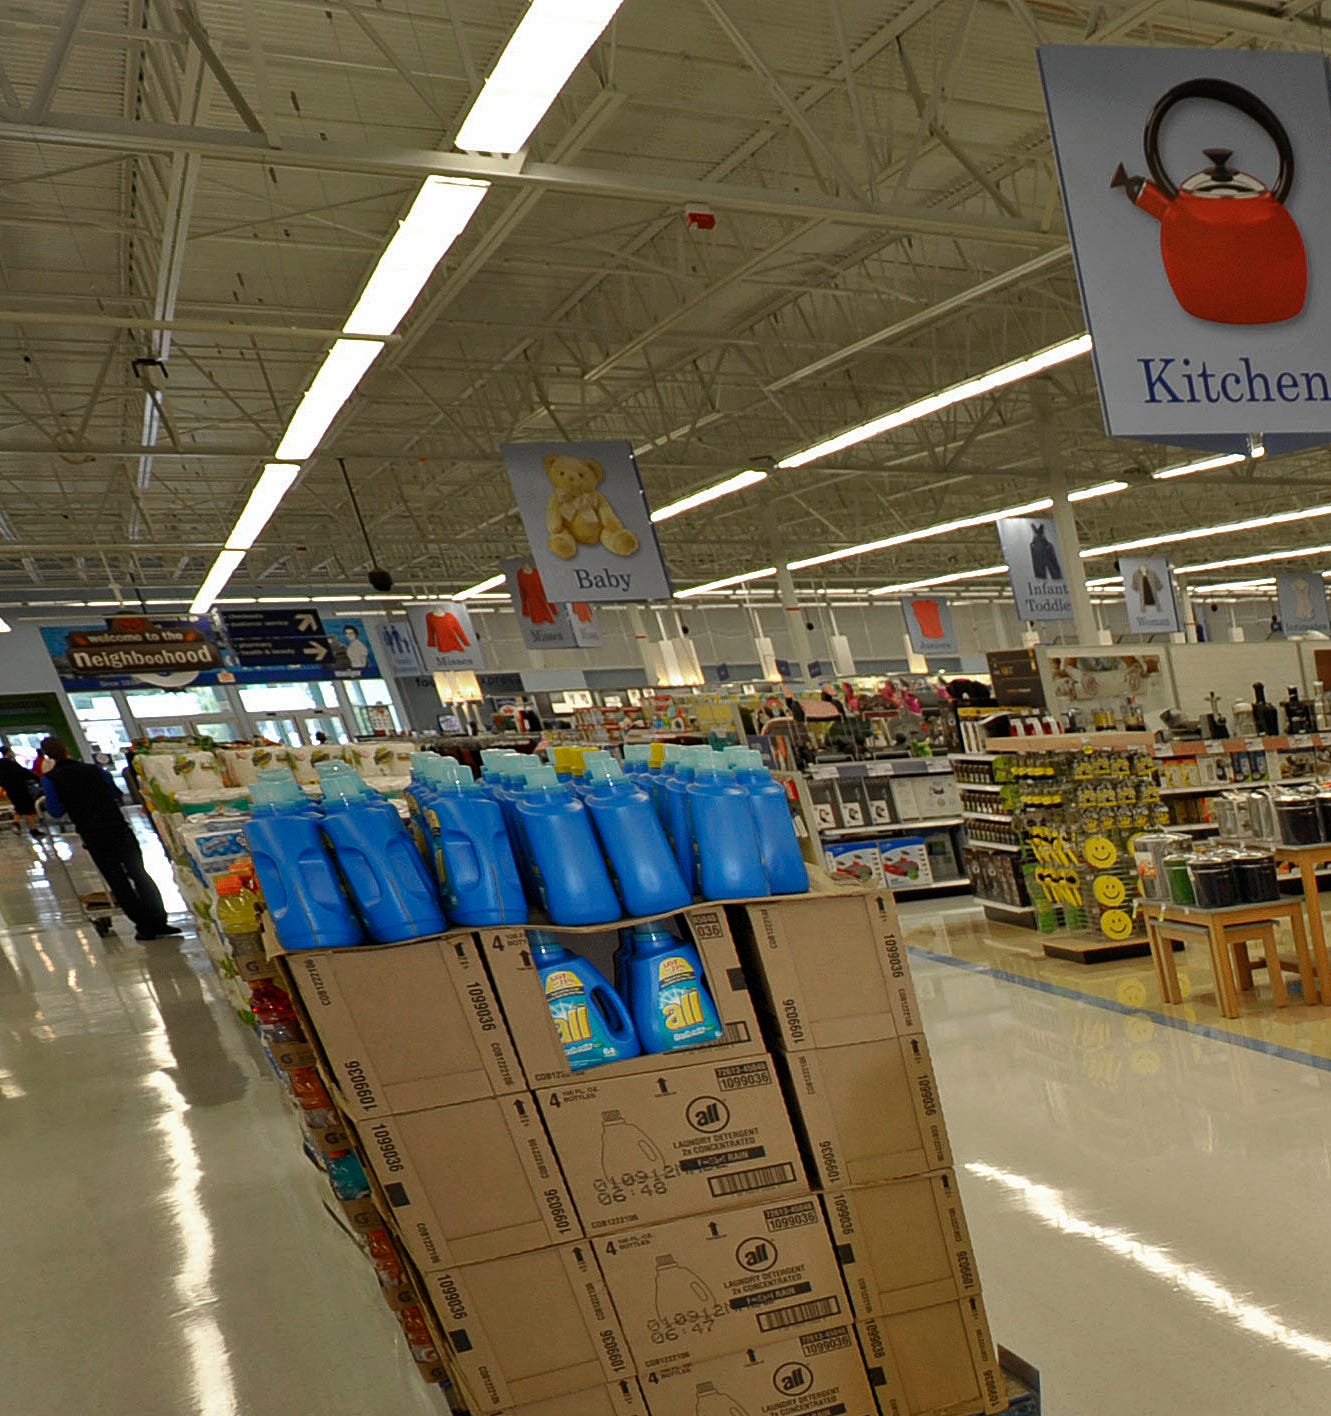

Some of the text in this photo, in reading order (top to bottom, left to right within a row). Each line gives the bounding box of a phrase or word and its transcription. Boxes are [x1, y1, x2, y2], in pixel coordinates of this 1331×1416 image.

[574, 568, 632, 592] Baby
[1027, 582, 1069, 596] Infant
[1025, 599, 1072, 612] Toddle
[87, 631, 184, 643] welcome to the
[493, 935, 504, 951] 4
[884, 934, 904, 978] 1099036
[467, 982, 497, 1032] 1099036
[663, 990, 704, 1030] all
[554, 1007, 592, 1044] all
[783, 999, 804, 1044] 1099036
[344, 1061, 378, 1112] 1099036
[720, 1072, 768, 1089] 1099036
[550, 1093, 560, 1108] 4
[918, 1075, 937, 1116] 1099036
[695, 1103, 720, 1127] all
[371, 1123, 404, 1173] 1099036
[673, 1127, 759, 1149] LAUNDRY DETERGENT
[693, 1137, 755, 1153] CONCENTRATED
[819, 1141, 840, 1183] 1099036
[597, 1181, 668, 1206] 06:48
[545, 1189, 572, 1235] 1099036
[769, 1215, 815, 1231] 1099036
[834, 1193, 854, 1236] 1099036
[605, 1241, 617, 1256] 4
[744, 1243, 768, 1266] all
[723, 1264, 806, 1288] LAUNDRY DETERGENT
[743, 1274, 802, 1292] CONCENTRATED
[438, 1275, 467, 1320] 1099036
[652, 1319, 715, 1344] 06:47
[865, 1319, 885, 1359] 1099036
[600, 1330, 625, 1373] 1099036
[804, 1337, 850, 1355] 1099036
[648, 1371, 659, 1384] 4
[781, 1367, 804, 1390] all
[780, 1396, 837, 1416] CONCENTRATED
[799, 1387, 840, 1402] DETERGENT
